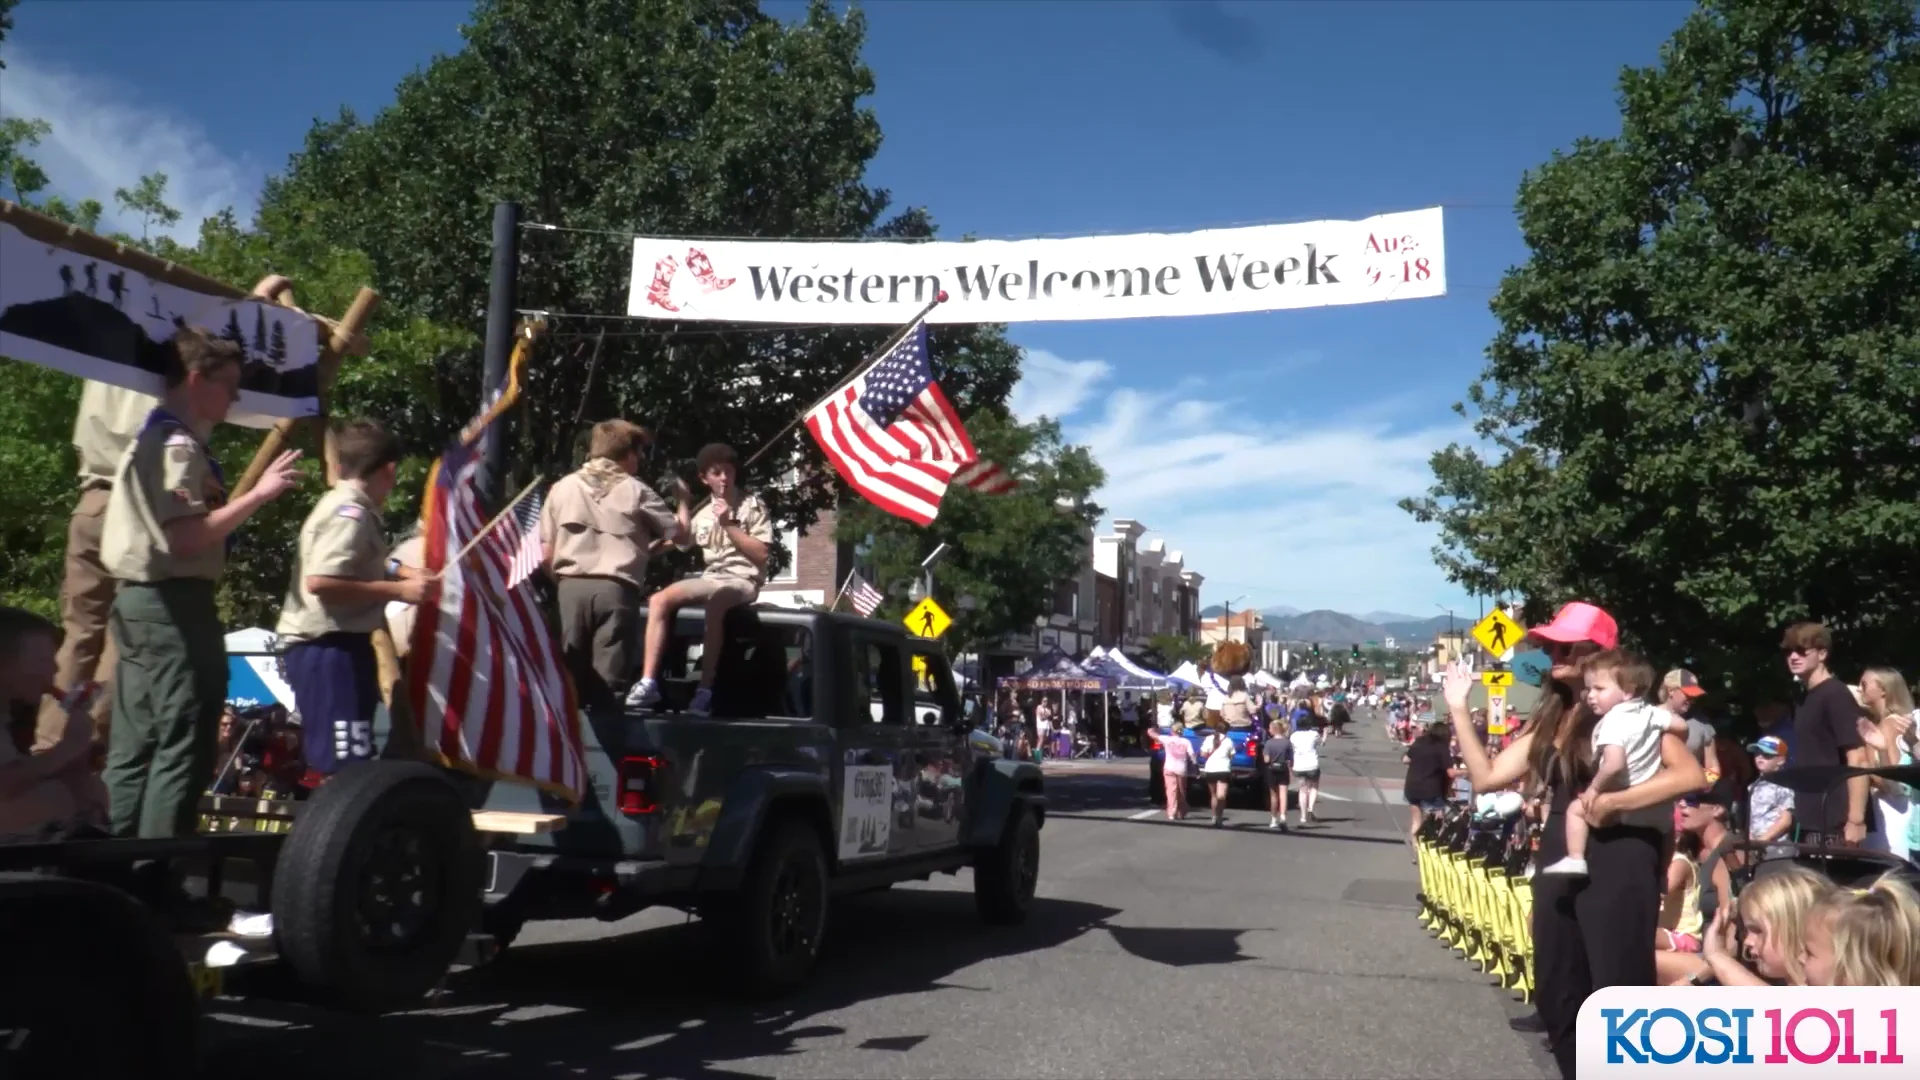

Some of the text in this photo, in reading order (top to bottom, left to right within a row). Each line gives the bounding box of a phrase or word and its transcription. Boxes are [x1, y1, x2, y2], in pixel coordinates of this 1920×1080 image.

[1364, 232, 1420, 255] Aug.
[748, 243, 1342, 304] Western Welcome Week
